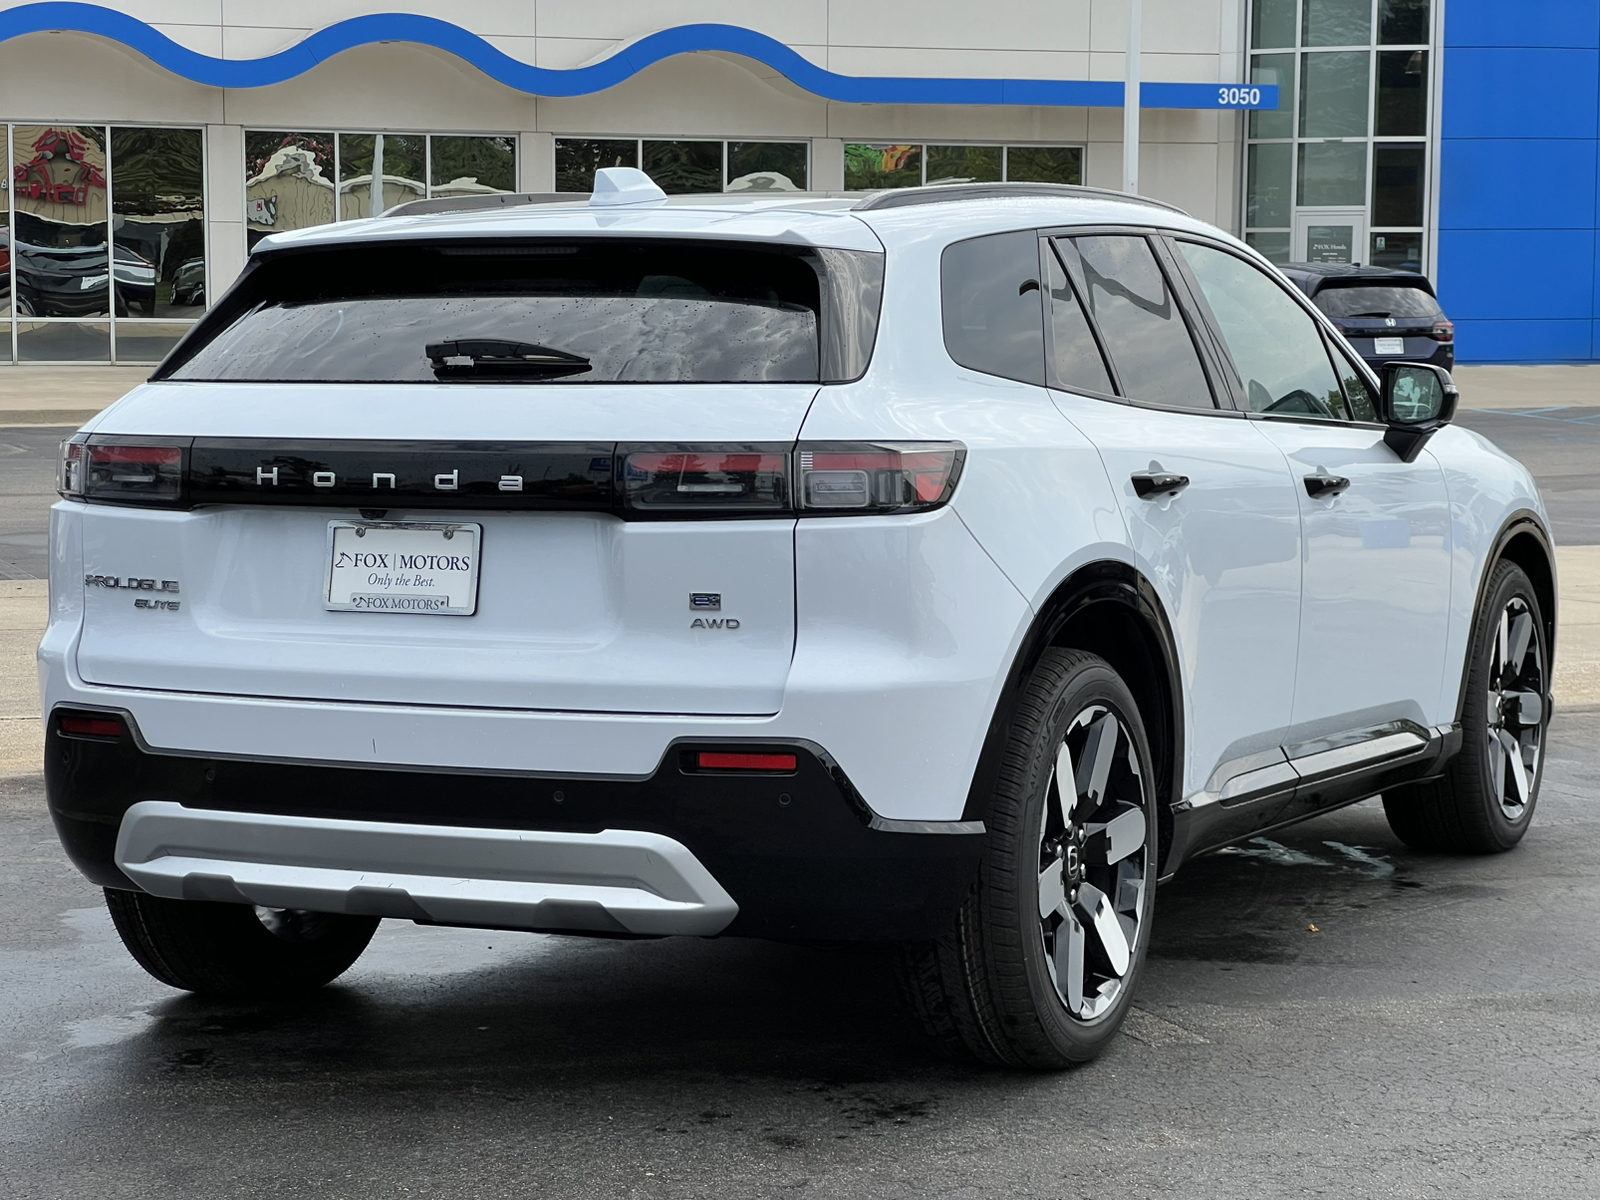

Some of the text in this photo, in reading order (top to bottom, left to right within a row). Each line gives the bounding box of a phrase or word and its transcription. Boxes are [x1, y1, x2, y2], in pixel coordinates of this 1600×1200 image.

[1218, 87, 1260, 105] 3050
[256, 467, 523, 491] Honda
[353, 552, 470, 571] FOX MOTORS
[85, 574, 180, 593] PROLOGUE
[367, 572, 435, 589] Only the Best.
[134, 598, 181, 611] ELITE
[366, 597, 440, 611] FOX MOTORS
[690, 618, 740, 629] AWD
